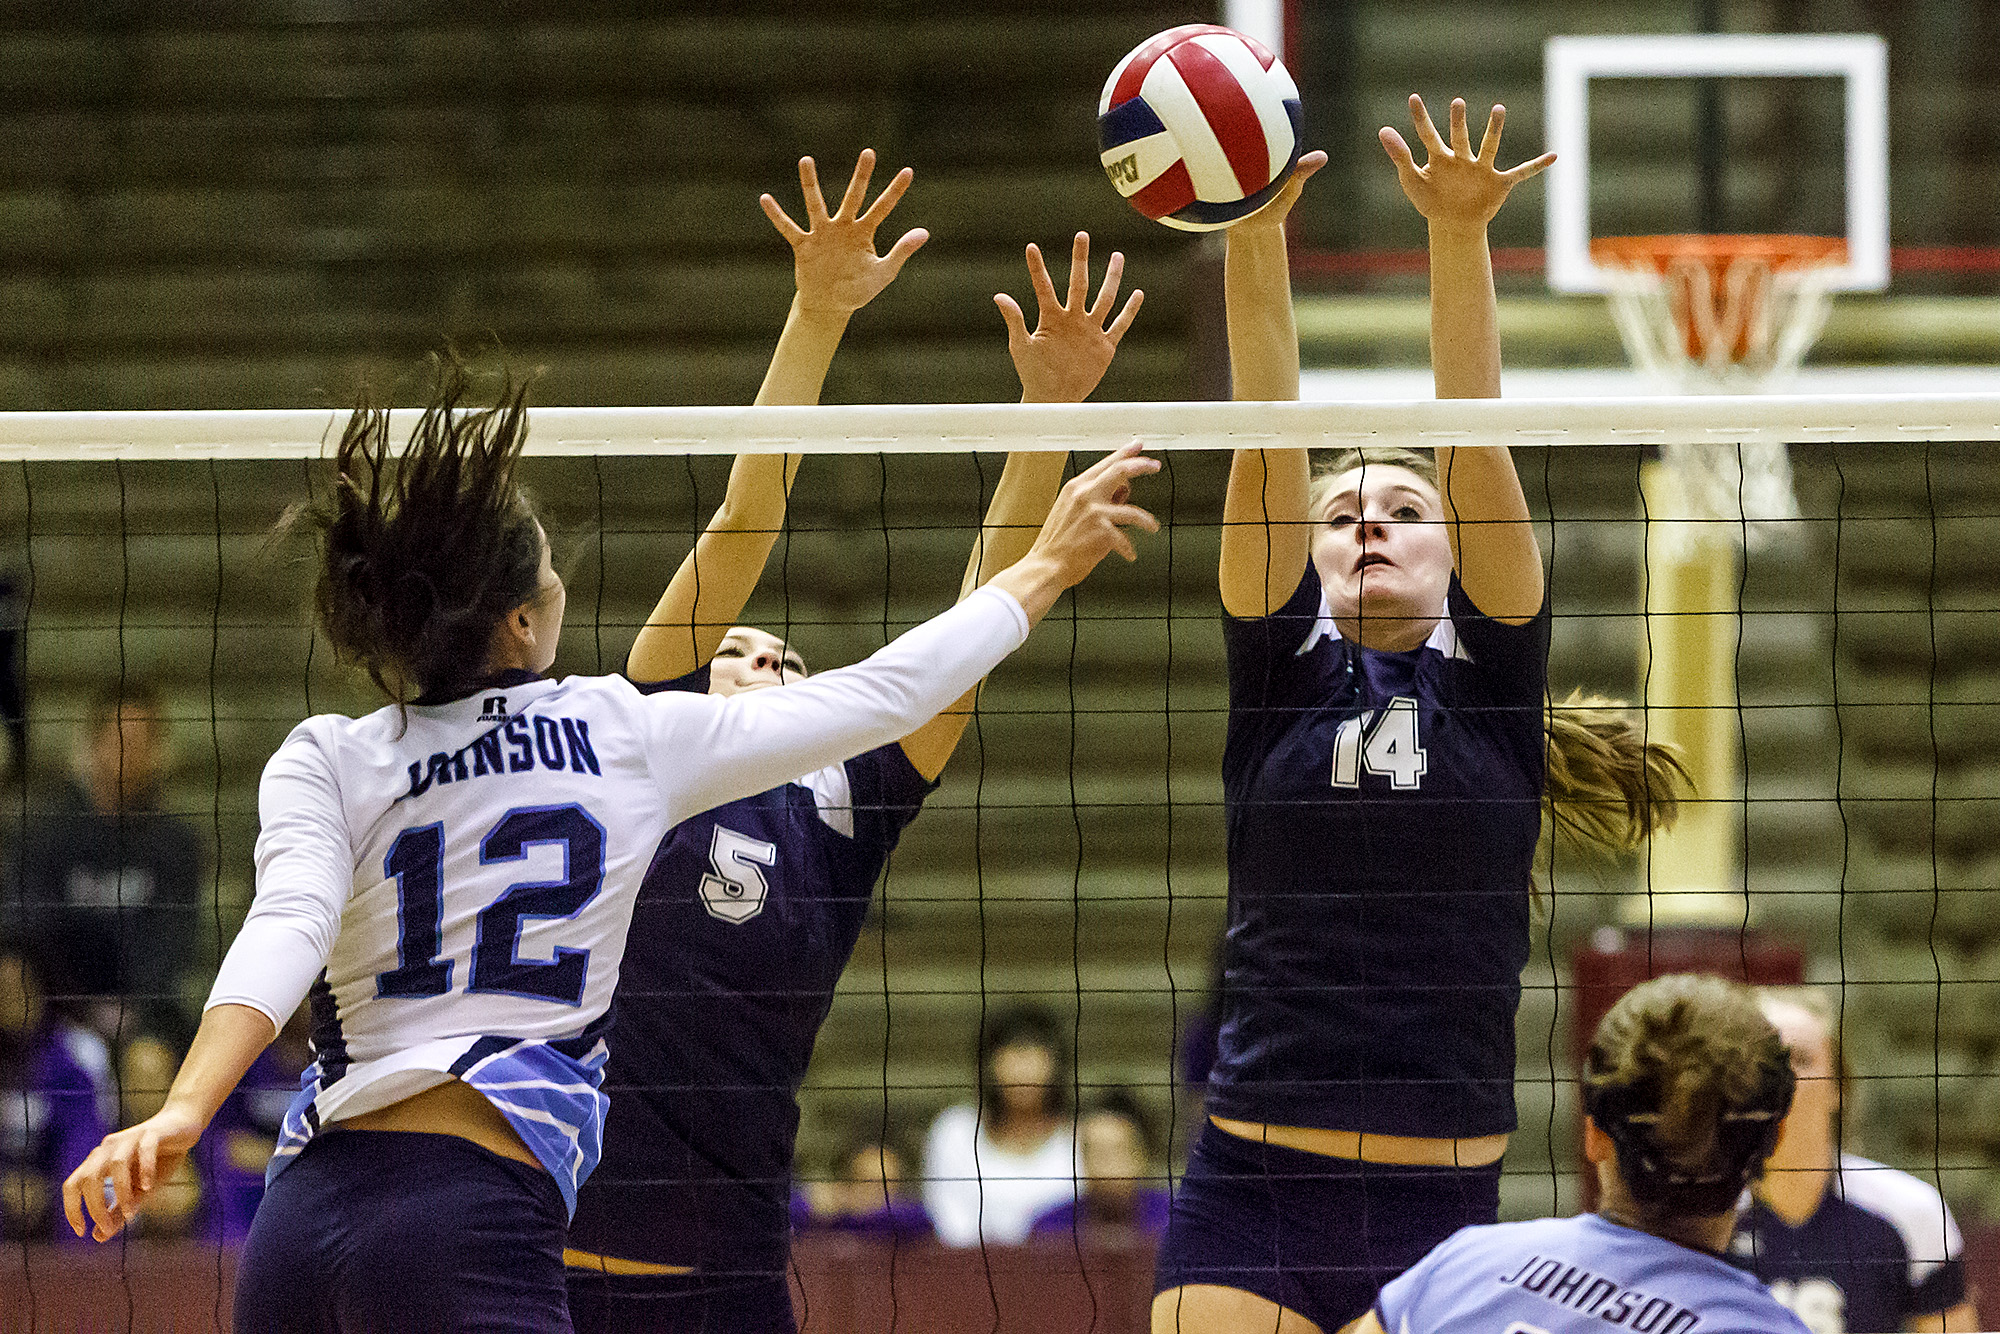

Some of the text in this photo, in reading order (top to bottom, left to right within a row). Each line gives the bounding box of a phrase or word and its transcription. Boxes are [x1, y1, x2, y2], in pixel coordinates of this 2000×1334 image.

[1331, 696, 1428, 789] 14
[373, 801, 607, 1007] 12
[698, 823, 777, 925] 5
[1498, 1255, 1700, 1334] JOHNSON
